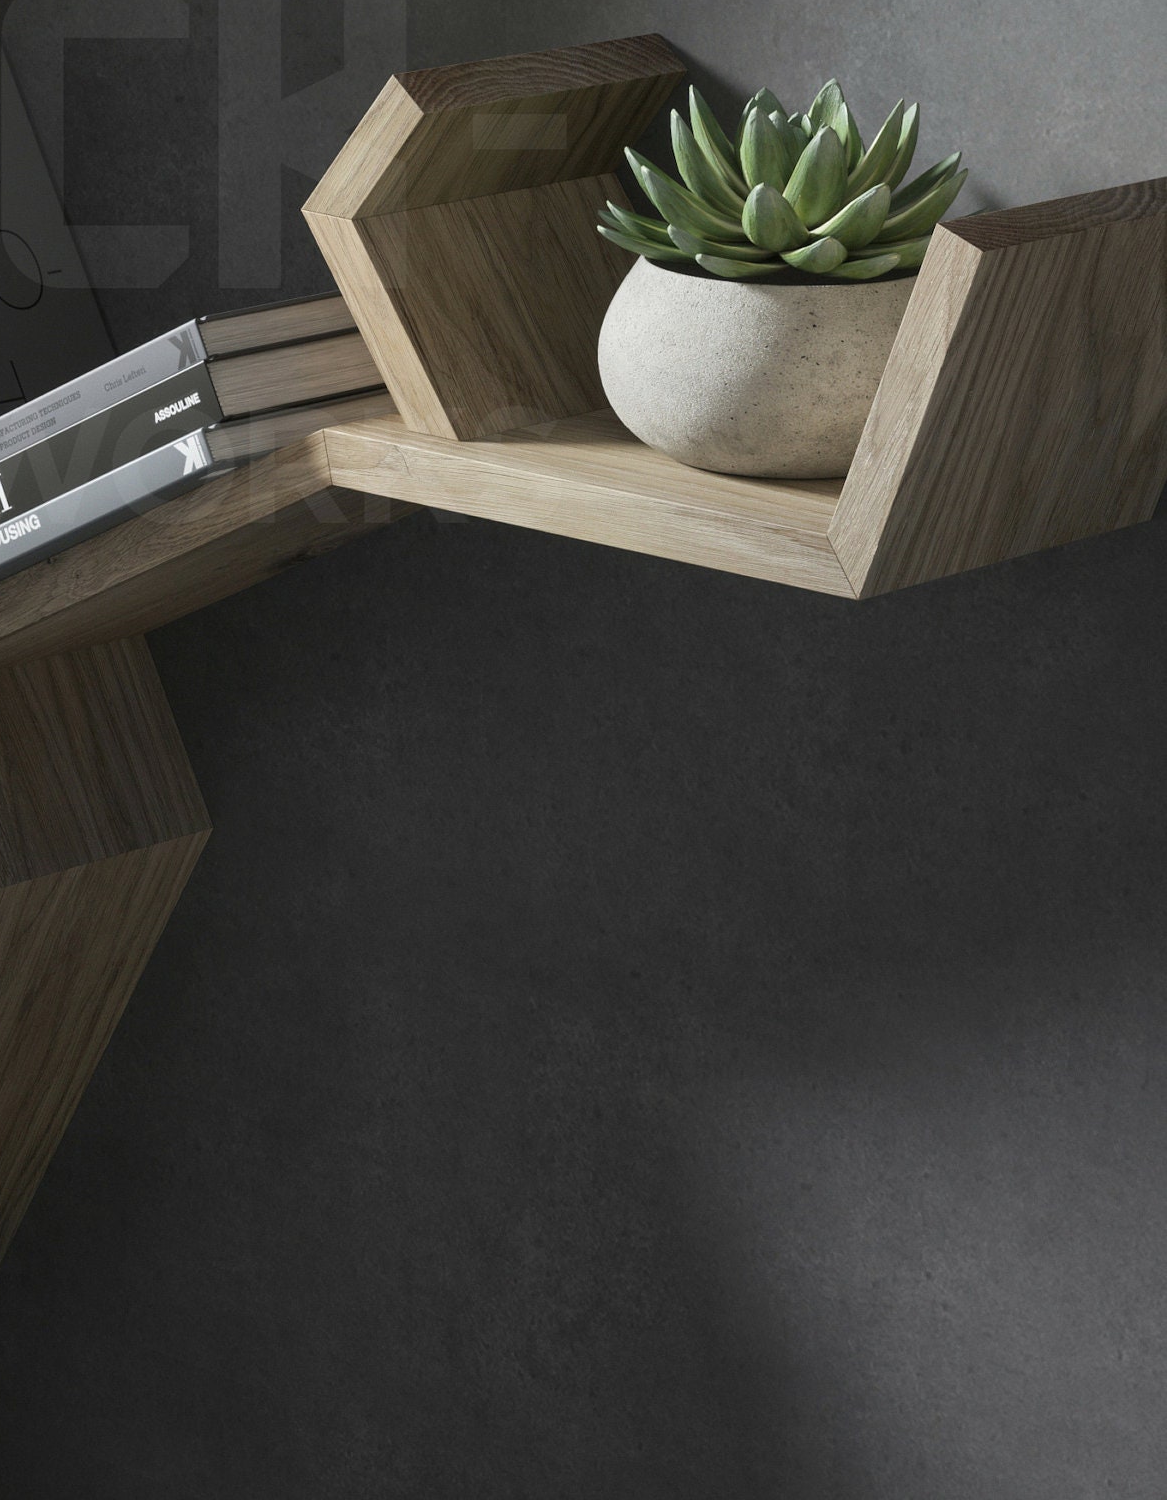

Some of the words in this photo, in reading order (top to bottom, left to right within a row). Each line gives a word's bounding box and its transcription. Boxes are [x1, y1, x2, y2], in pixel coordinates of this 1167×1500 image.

[104, 379, 123, 393] Chris
[154, 391, 201, 424] ASSOULINE
[29, 416, 57, 435] DESIGN
